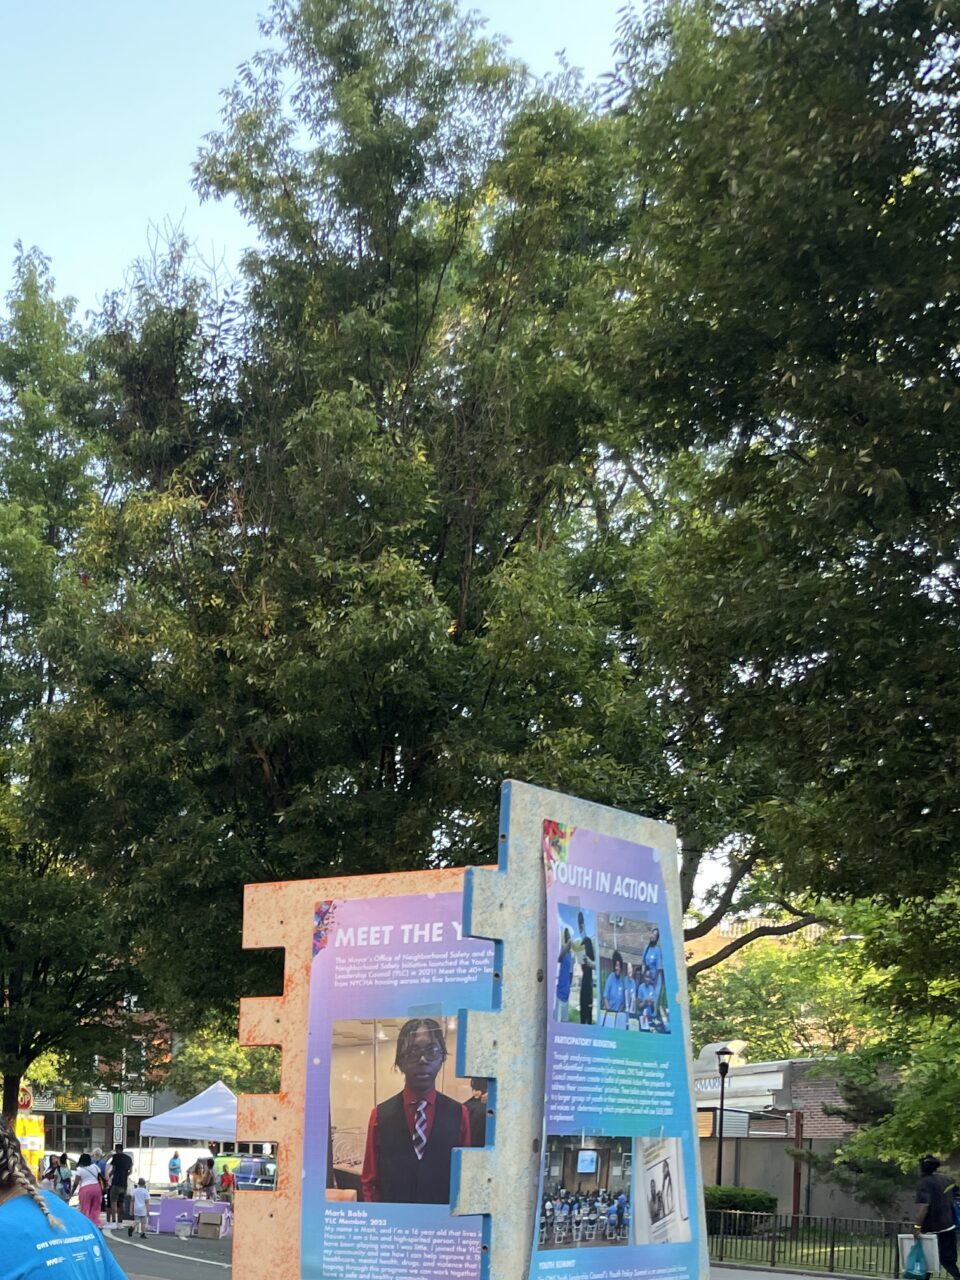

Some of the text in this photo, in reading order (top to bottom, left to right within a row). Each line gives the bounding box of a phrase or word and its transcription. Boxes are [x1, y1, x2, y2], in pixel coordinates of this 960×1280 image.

[551, 860, 659, 904] YOUTH IN ACTION
[335, 923, 443, 947] MEET THE
[374, 954, 392, 962] Office
[403, 952, 448, 961] Neighborhood
[450, 950, 470, 959] Safety
[336, 964, 378, 974] Neighborhood
[381, 962, 400, 970] Safety
[402, 961, 427, 969] Initiative
[375, 979, 398, 987] housing
[19, 1095, 30, 1105] OP
[451, 1270, 477, 1278] together
